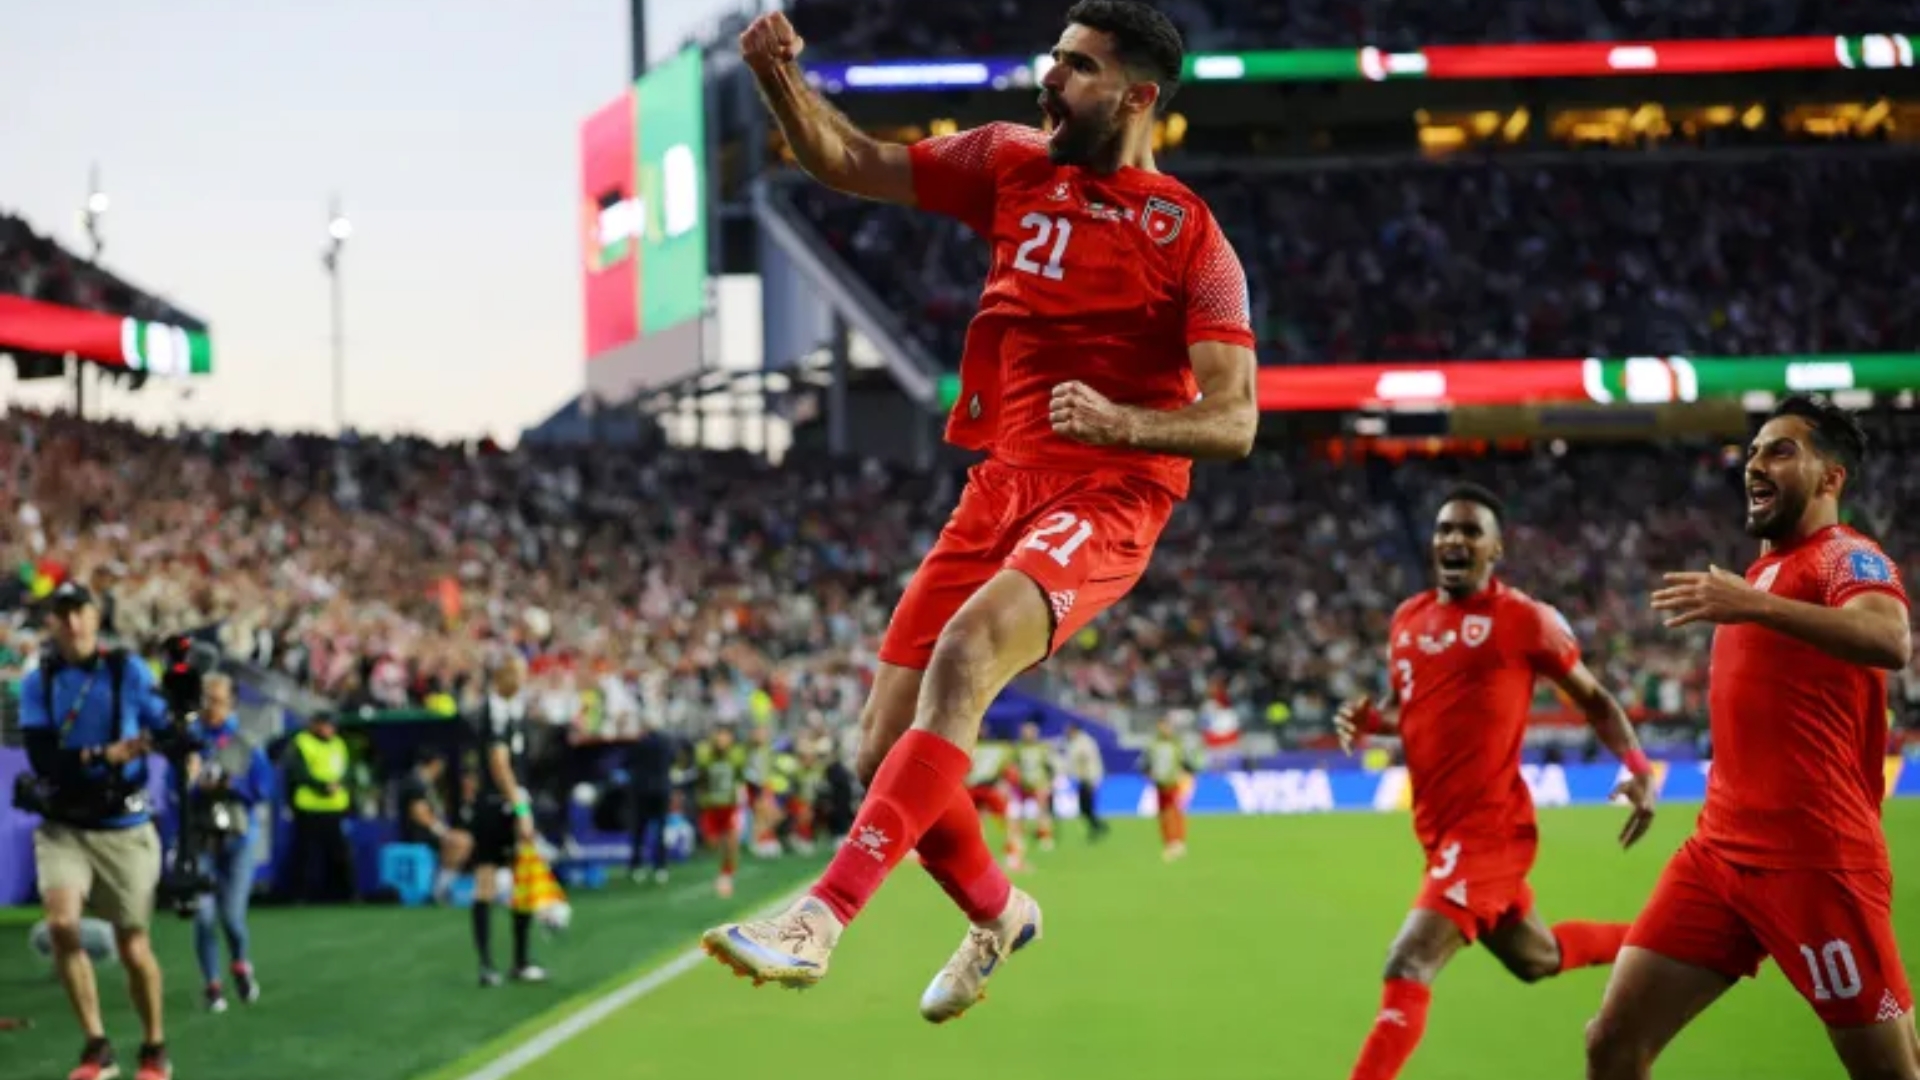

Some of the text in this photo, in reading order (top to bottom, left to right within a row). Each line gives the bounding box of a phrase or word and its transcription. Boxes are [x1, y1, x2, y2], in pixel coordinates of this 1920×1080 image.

[1013, 211, 1072, 281] 21
[1025, 511, 1093, 567] 21
[1227, 768, 1334, 812] VISA
[1429, 841, 1462, 879] 3
[1799, 938, 1862, 1000] 10
